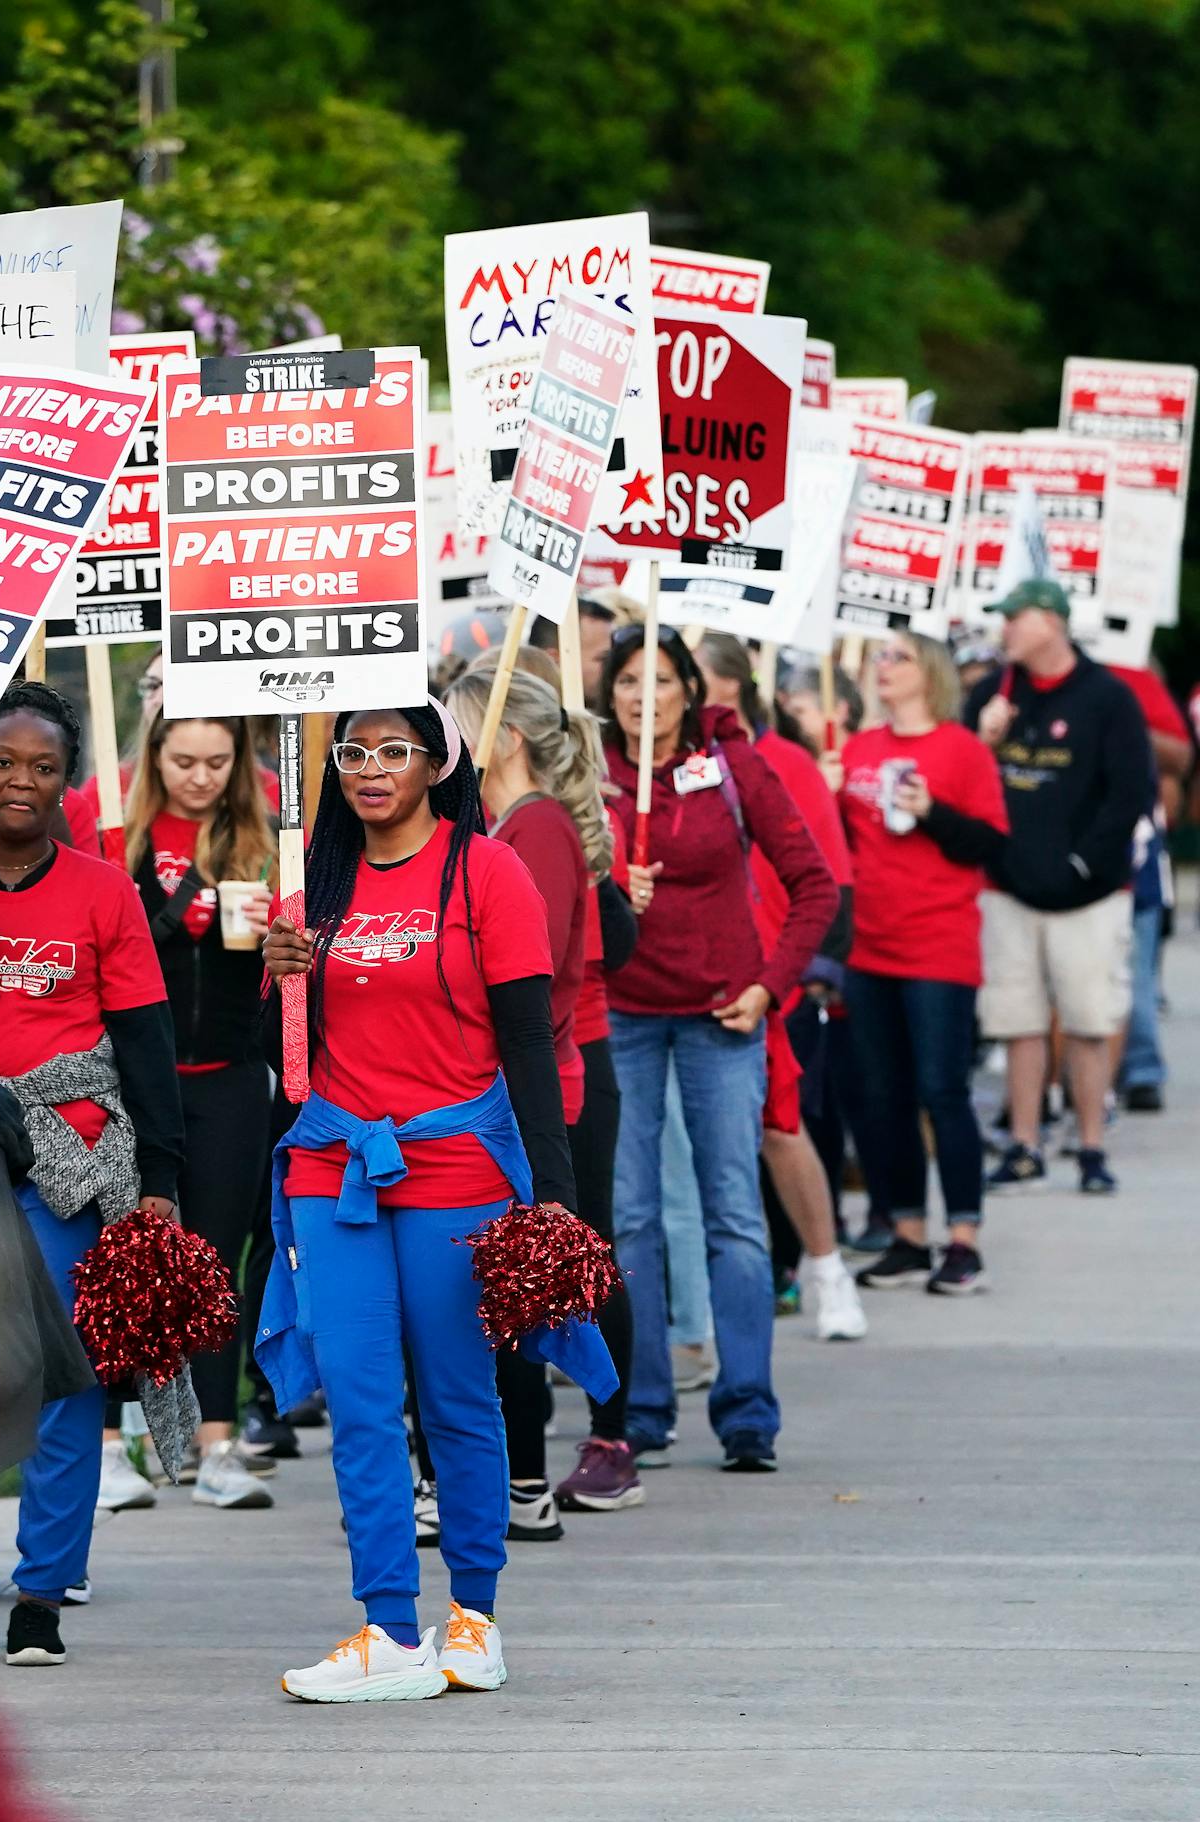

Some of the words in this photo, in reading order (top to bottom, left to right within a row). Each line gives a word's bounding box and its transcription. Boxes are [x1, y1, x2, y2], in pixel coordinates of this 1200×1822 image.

[459, 258, 538, 309] MY
[547, 246, 632, 296] MOM
[651, 267, 757, 304] TIENTS
[551, 302, 634, 365] PATIENTS
[245, 365, 325, 392] STRIKE
[249, 357, 271, 366] Unfair
[272, 357, 293, 365] Labor
[294, 356, 324, 364] Practice
[557, 349, 603, 388] BEFORE
[533, 378, 610, 441] PROFITS
[225, 421, 355, 450] BEFORE
[183, 461, 401, 507] PROFITS
[171, 521, 415, 567] PATIENTS
[503, 506, 577, 570] PROFITS
[76, 558, 160, 594] OFIT
[229, 571, 359, 600] BEFORE
[75, 610, 144, 635] STRIKE
[186, 612, 405, 657] PROFITS
[261, 671, 334, 686] MNA
[287, 720, 297, 733] For
[287, 734, 298, 759] Public
[288, 759, 299, 805] Information
[289, 805, 299, 823] Only
[16, 965, 76, 979] Association
